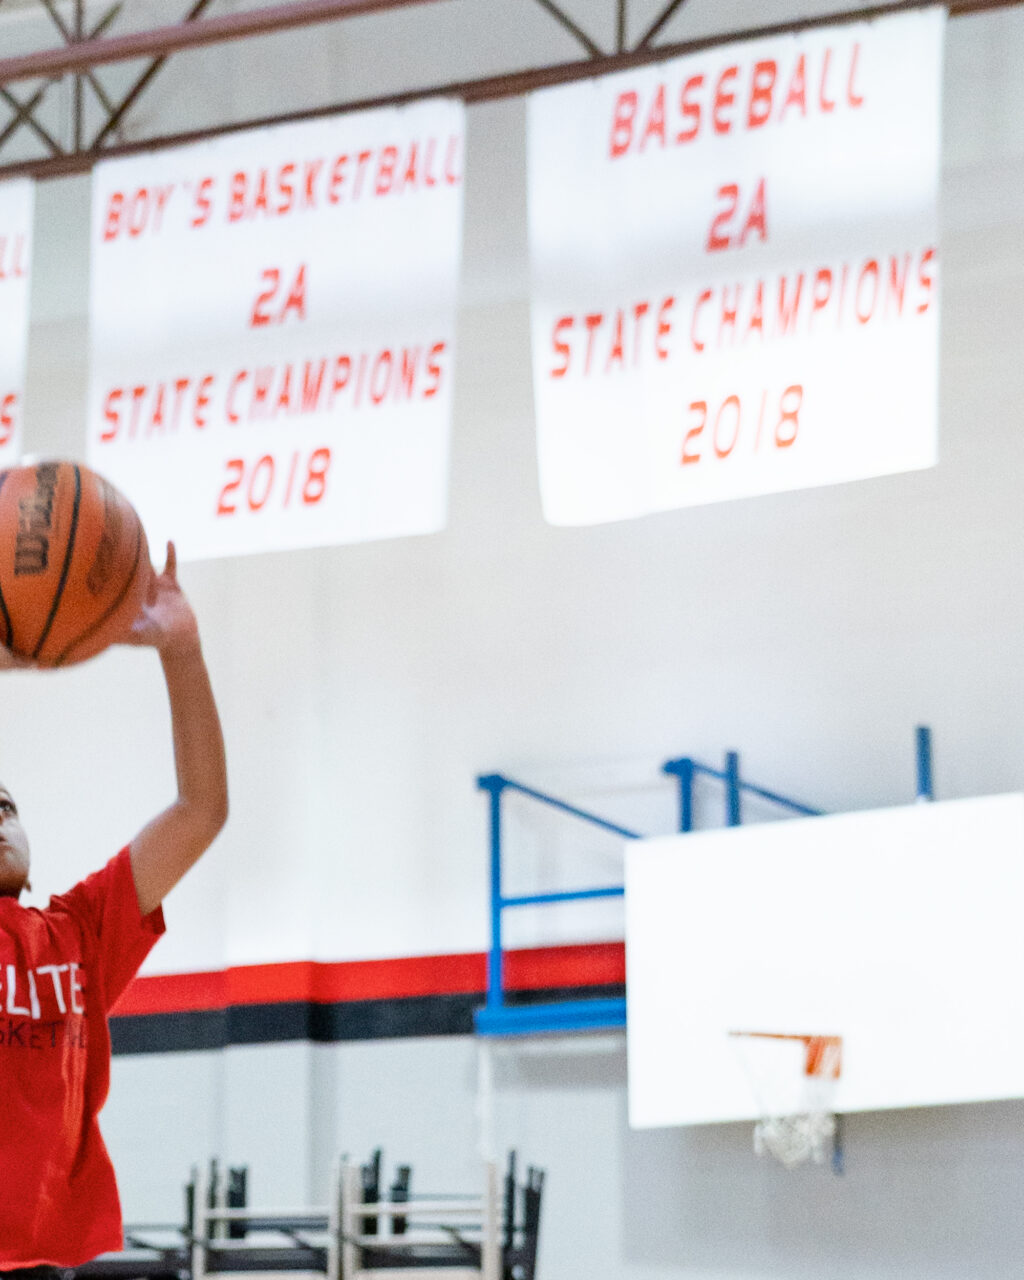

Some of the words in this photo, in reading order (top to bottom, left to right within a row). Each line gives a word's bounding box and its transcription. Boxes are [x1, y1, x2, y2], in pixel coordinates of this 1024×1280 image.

[609, 43, 866, 159] BASEBALL
[103, 177, 214, 243] BOY'S
[227, 134, 463, 222] BASKETBALL
[706, 177, 768, 253] 2A
[249, 263, 308, 328] 2A
[549, 296, 676, 379] STATE
[689, 247, 938, 354] CHAMPIONS
[100, 374, 215, 444] STATE
[226, 340, 447, 424] CHAMPIONS
[681, 384, 804, 466] 2018
[216, 447, 332, 517] 2018
